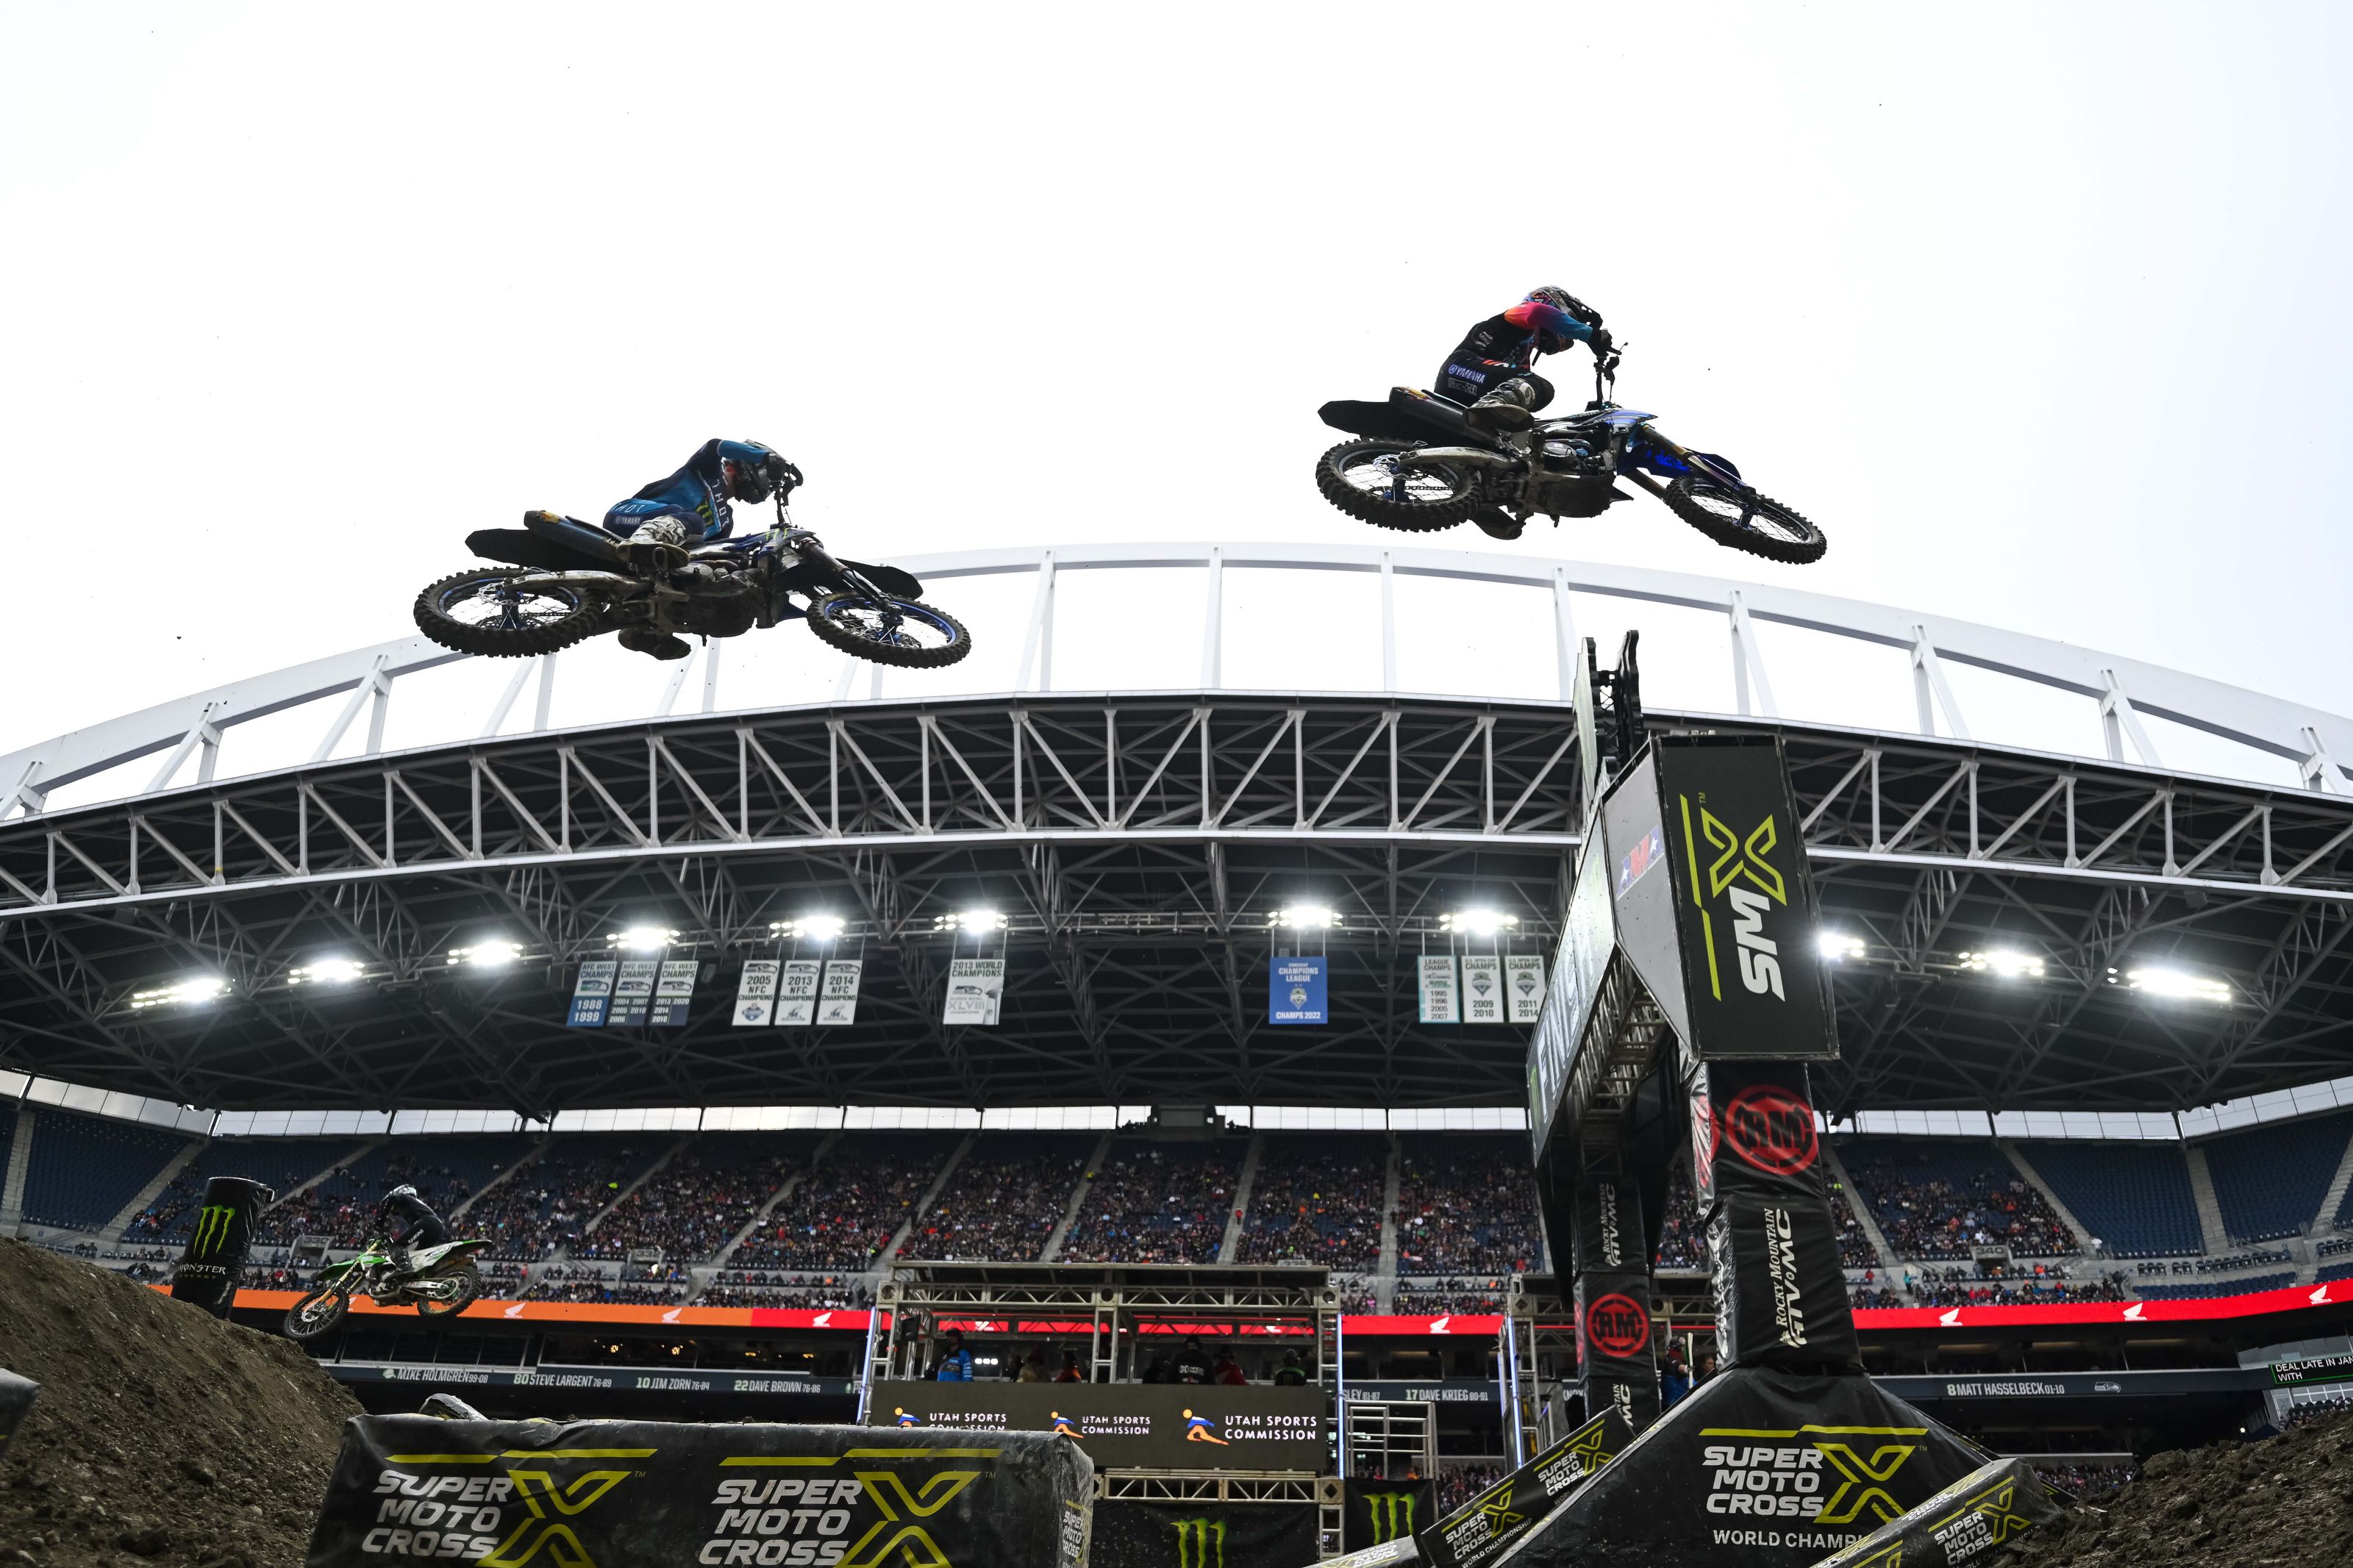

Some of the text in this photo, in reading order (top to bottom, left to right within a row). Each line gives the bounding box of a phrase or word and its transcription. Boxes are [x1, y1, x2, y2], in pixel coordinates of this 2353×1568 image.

[1456, 367, 1485, 383] YAMAHA
[580, 970, 614, 978] CHAMPS
[621, 970, 655, 978] CHAMPS
[662, 970, 695, 978] CHAMPS
[1278, 967, 1319, 975] CHAMPIONS
[746, 975, 771, 985] 2005
[788, 976, 813, 985] 2013
[829, 976, 854, 985] 2014
[578, 1000, 602, 1010] 1988
[947, 1001, 985, 1010] XLVIII
[1473, 1000, 1493, 1008] 2009
[1518, 1000, 1537, 1008] 2011
[574, 1012, 600, 1023] 1999
[1276, 1012, 1321, 1020] CHAMPS 2022
[1474, 1009, 1493, 1017] 2010
[1518, 1009, 1539, 1017] 2014
[1976, 1247, 2004, 1255] 340
[1764, 1208, 1788, 1328] ROCKY MOUNTAIN
[2276, 1363, 2300, 1372] DEAL
[2301, 1359, 2324, 1369] LATE
[2325, 1358, 2336, 1367] IN
[397, 1368, 488, 1383] MIKE HOLMGREN 99-08
[514, 1373, 612, 1388] 80 STEVE LARGENT 76-89
[2278, 1372, 2303, 1382] WITH
[636, 1377, 651, 1389] 10
[651, 1378, 668, 1389] JIM
[668, 1378, 692, 1390] ZORN
[734, 1380, 749, 1392] 22
[749, 1380, 770, 1392] DAVE
[771, 1381, 802, 1393] BROWN
[1947, 1383, 2065, 1396] 8 MATT HASSELBECK 01-10
[1406, 1389, 1418, 1400] 17
[1418, 1389, 1440, 1401] DAVE
[1441, 1389, 1468, 1401] KRIEG
[929, 1413, 1007, 1422] UTAH SPORTS
[1082, 1416, 1151, 1425] UTAH SPORTS
[1225, 1415, 1317, 1428] UTAH SPORTS
[1082, 1425, 1150, 1435] COMMISSION
[1224, 1428, 1317, 1441] COMMISSION
[1702, 1446, 1824, 1469] SUPER
[1538, 1451, 1579, 1482] SUPER
[1545, 1460, 1580, 1489] MOTO
[1713, 1469, 1820, 1493] MOTO
[372, 1469, 514, 1502] SUPER
[1546, 1467, 1585, 1497] CROSS
[711, 1479, 863, 1505] SUPER
[1706, 1493, 1824, 1517] CROSS
[376, 1498, 501, 1532] MOTO
[714, 1508, 851, 1535] MOTO
[1446, 1511, 1486, 1544] SUPER
[1934, 1511, 1984, 1545] SUPER
[1452, 1520, 1488, 1550] MOTO
[1713, 1529, 1780, 1545] WORLD
[1944, 1522, 1987, 1554] MOTO
[362, 1528, 499, 1558] CROSS
[1454, 1528, 1492, 1560] CROSS
[1462, 1517, 1532, 1568] WORLD CHAMPIONSHIP
[1947, 1531, 1993, 1566] CROSS
[699, 1539, 849, 1566] CROSS
